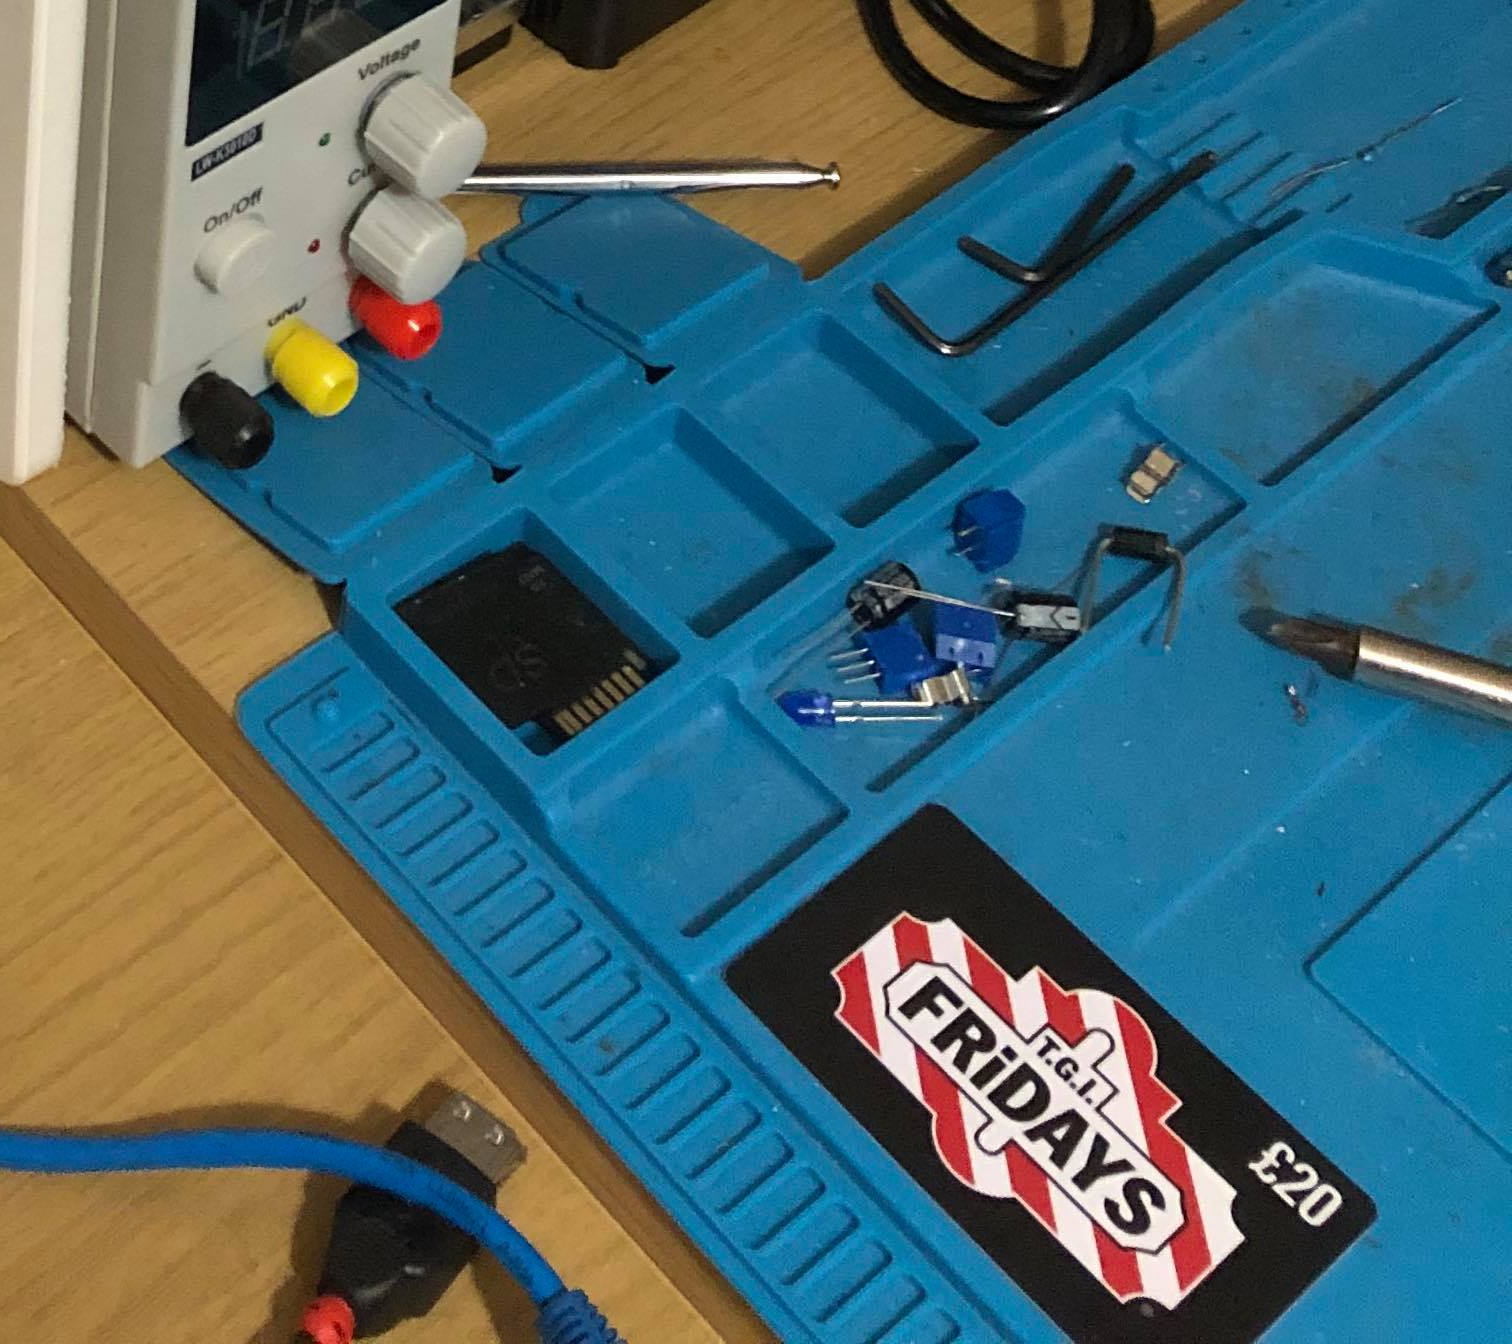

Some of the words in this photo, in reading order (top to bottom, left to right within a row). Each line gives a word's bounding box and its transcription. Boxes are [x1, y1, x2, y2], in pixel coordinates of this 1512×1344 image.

[357, 38, 422, 81] Voltage
[203, 184, 264, 234] On/Off
[1034, 1035, 1104, 1108] T.G.I.
[1246, 1139, 1344, 1229] £20
